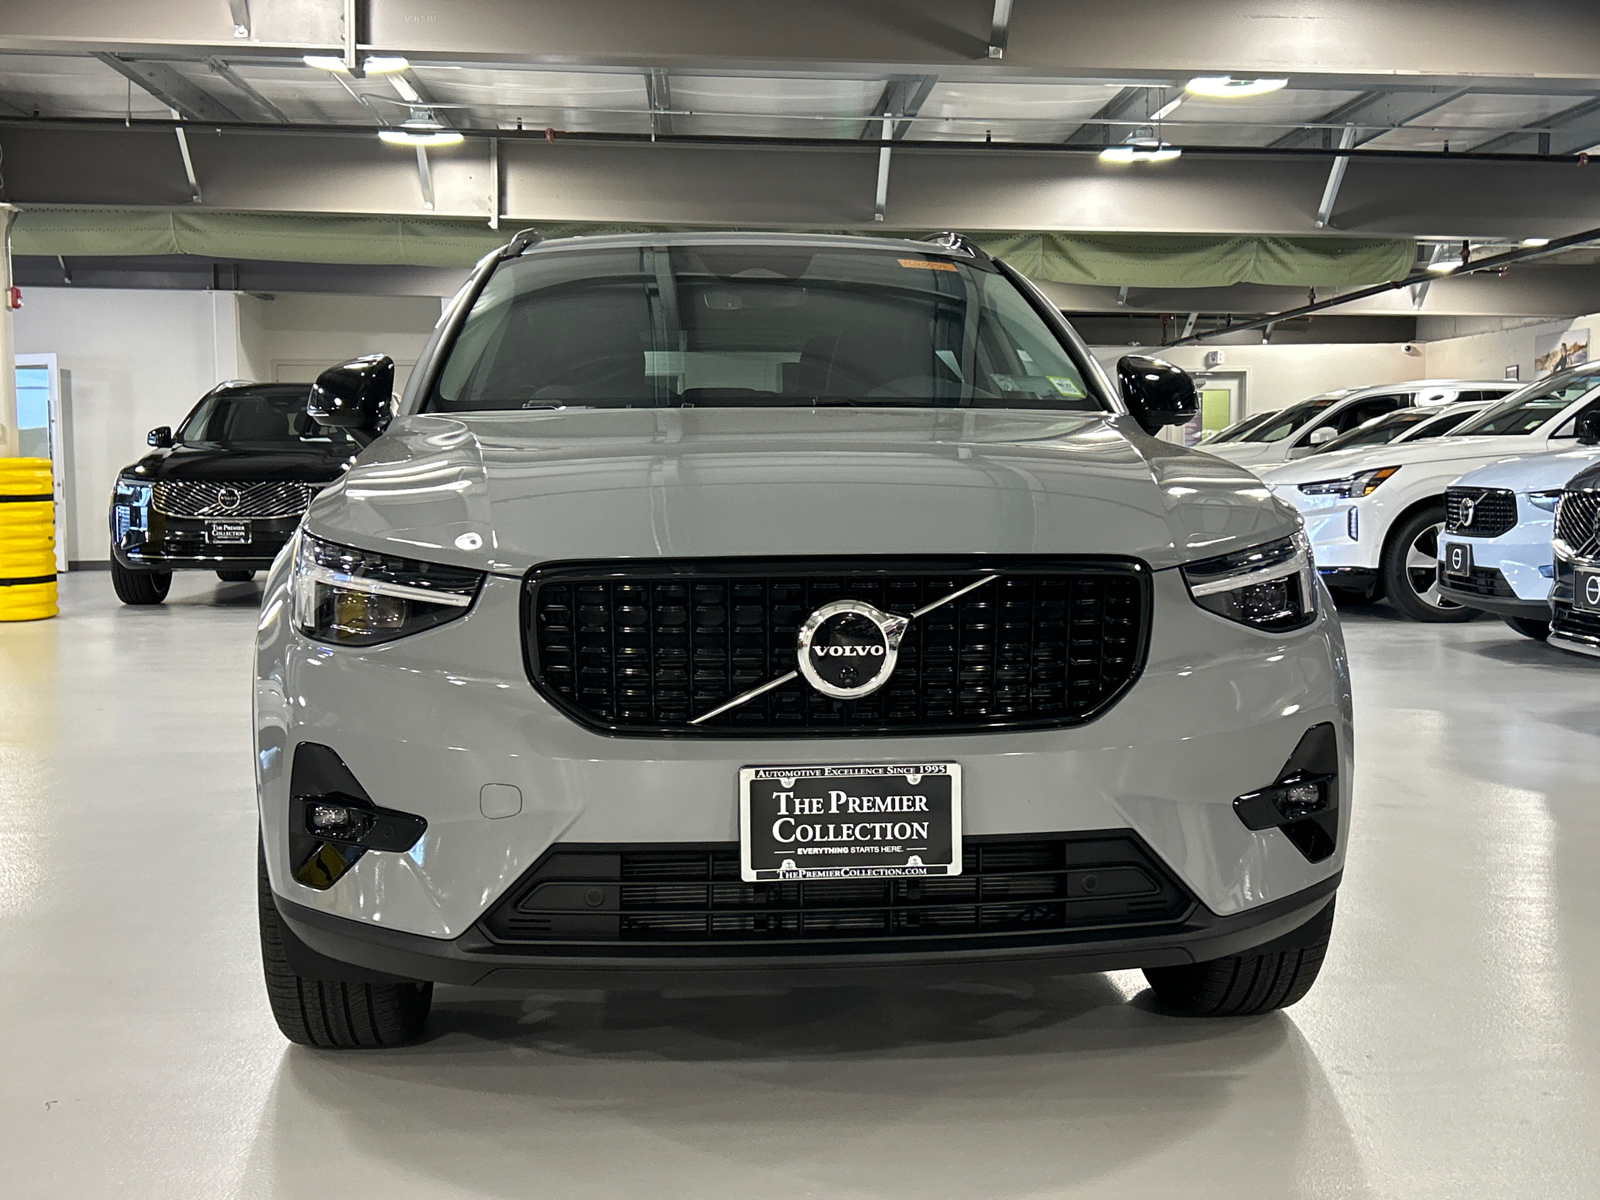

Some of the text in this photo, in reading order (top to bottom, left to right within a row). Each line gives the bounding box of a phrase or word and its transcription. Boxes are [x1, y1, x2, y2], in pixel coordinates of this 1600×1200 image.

[812, 645, 884, 657] VOLVO
[757, 764, 946, 778] AUTOMOTIVE EXCELLENCE SINCE 1995
[772, 790, 929, 816] THE PREMIER
[772, 817, 929, 843] COLLECTION
[797, 845, 904, 855] EVERYTHING STARTS HERE.
